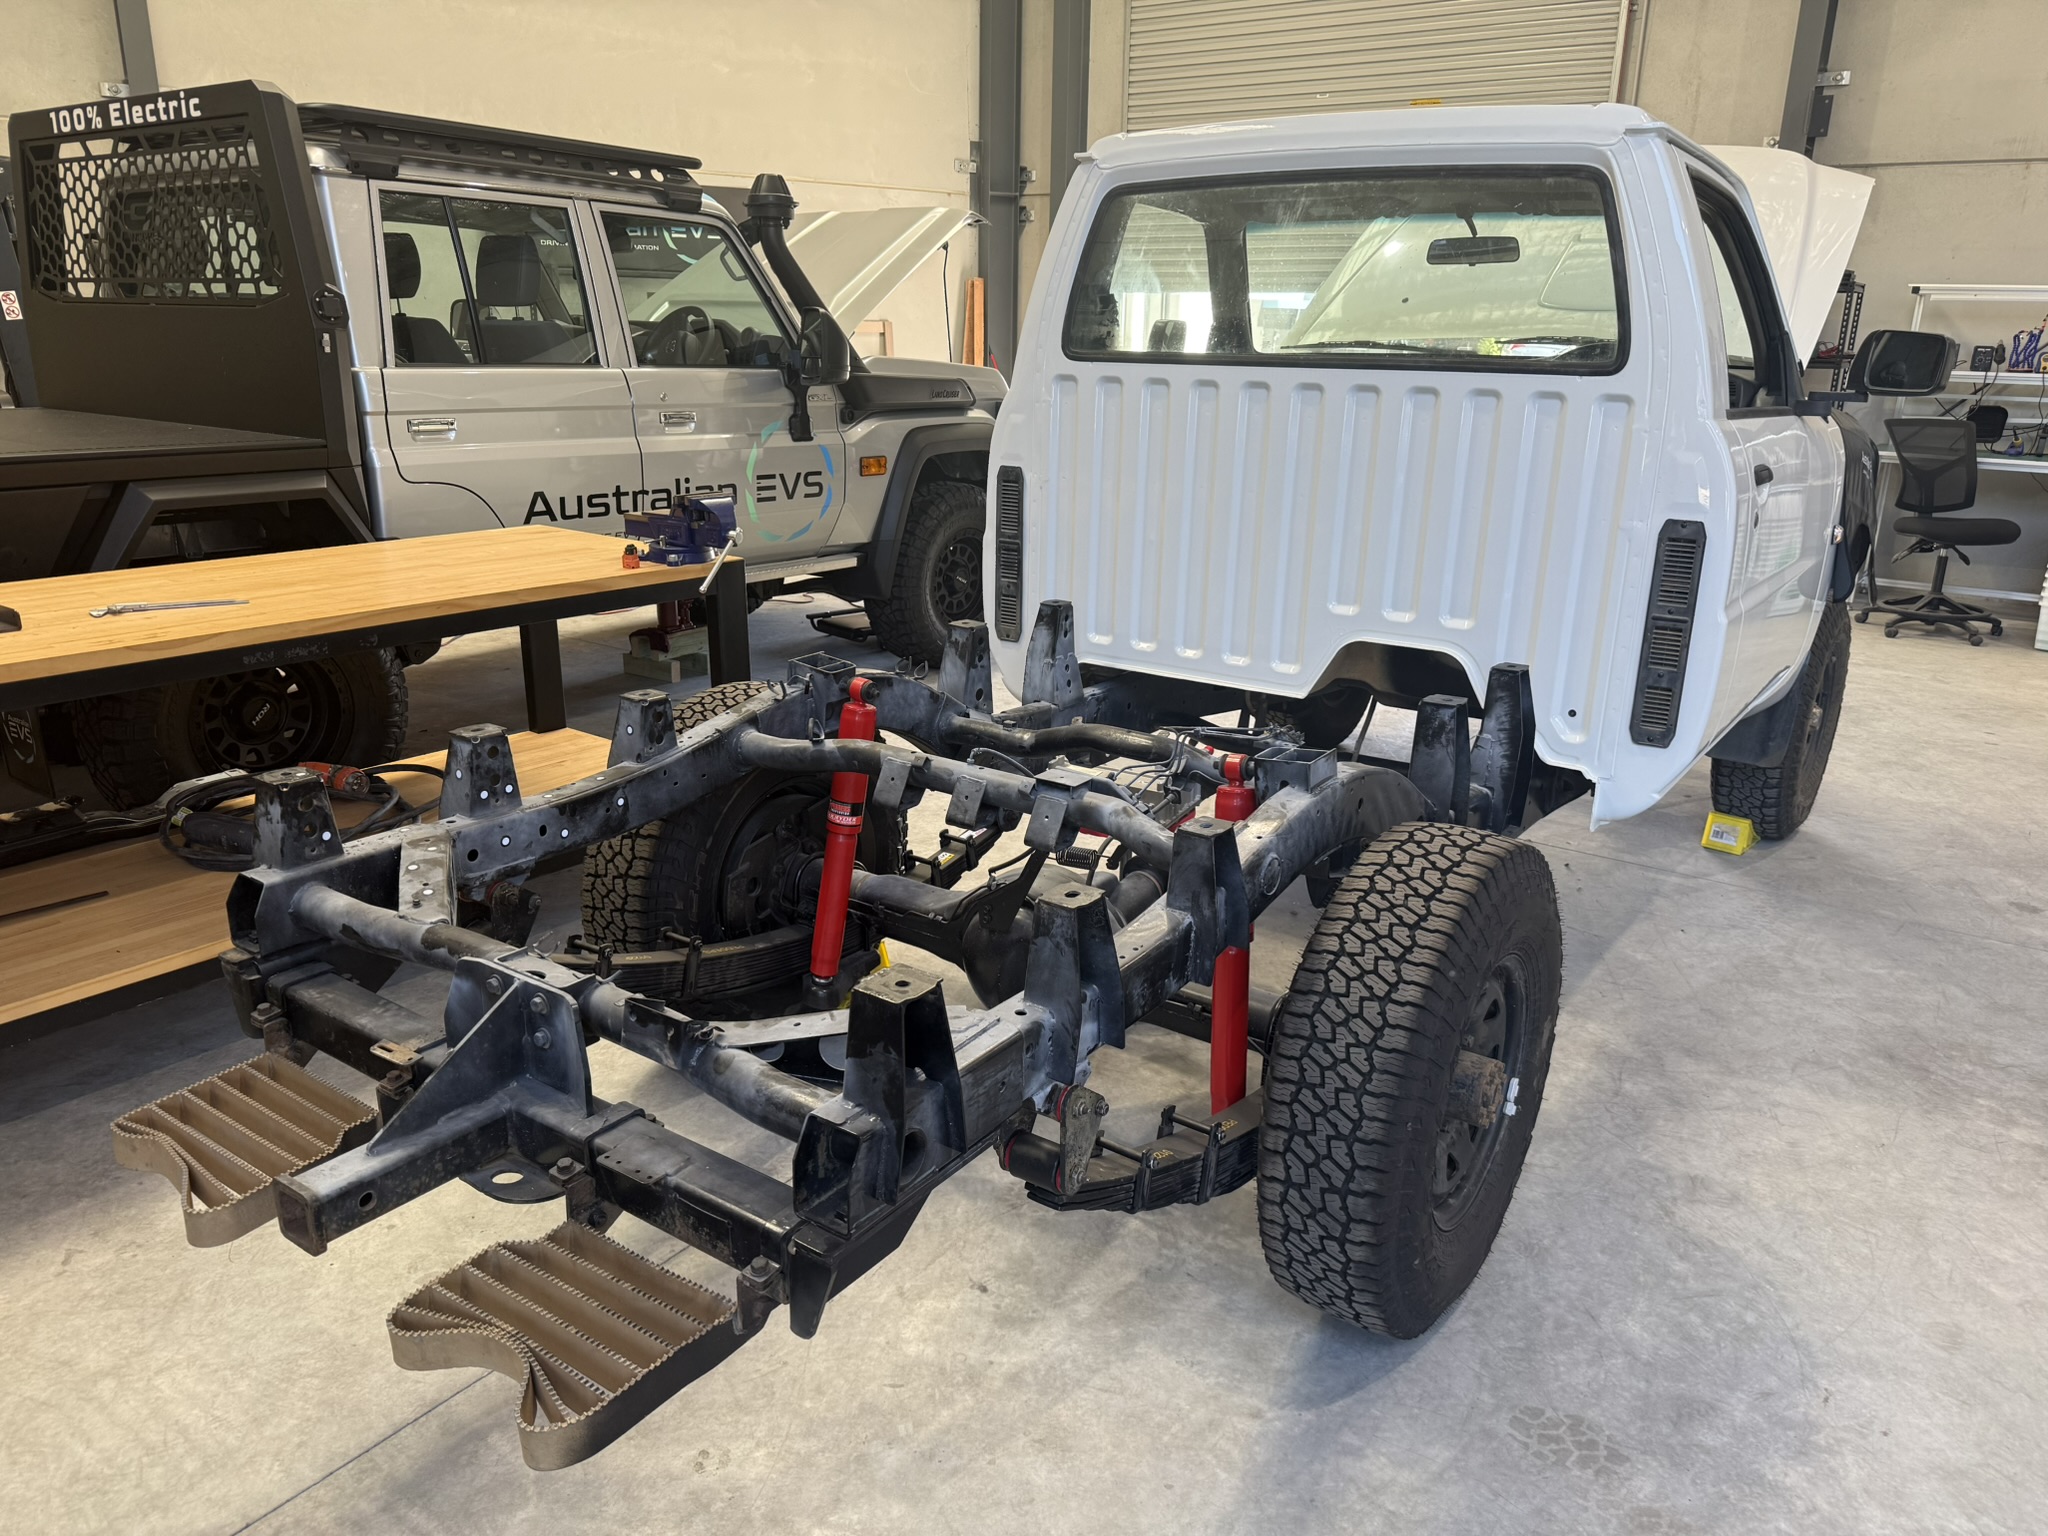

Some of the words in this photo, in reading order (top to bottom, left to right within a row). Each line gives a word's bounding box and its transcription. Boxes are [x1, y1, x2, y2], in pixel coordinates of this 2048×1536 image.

[49, 105, 103, 134] 100%
[108, 91, 202, 127] Electric
[756, 471, 823, 503] EVS
[252, 703, 271, 726] ROH
[9, 721, 33, 744] EVS
